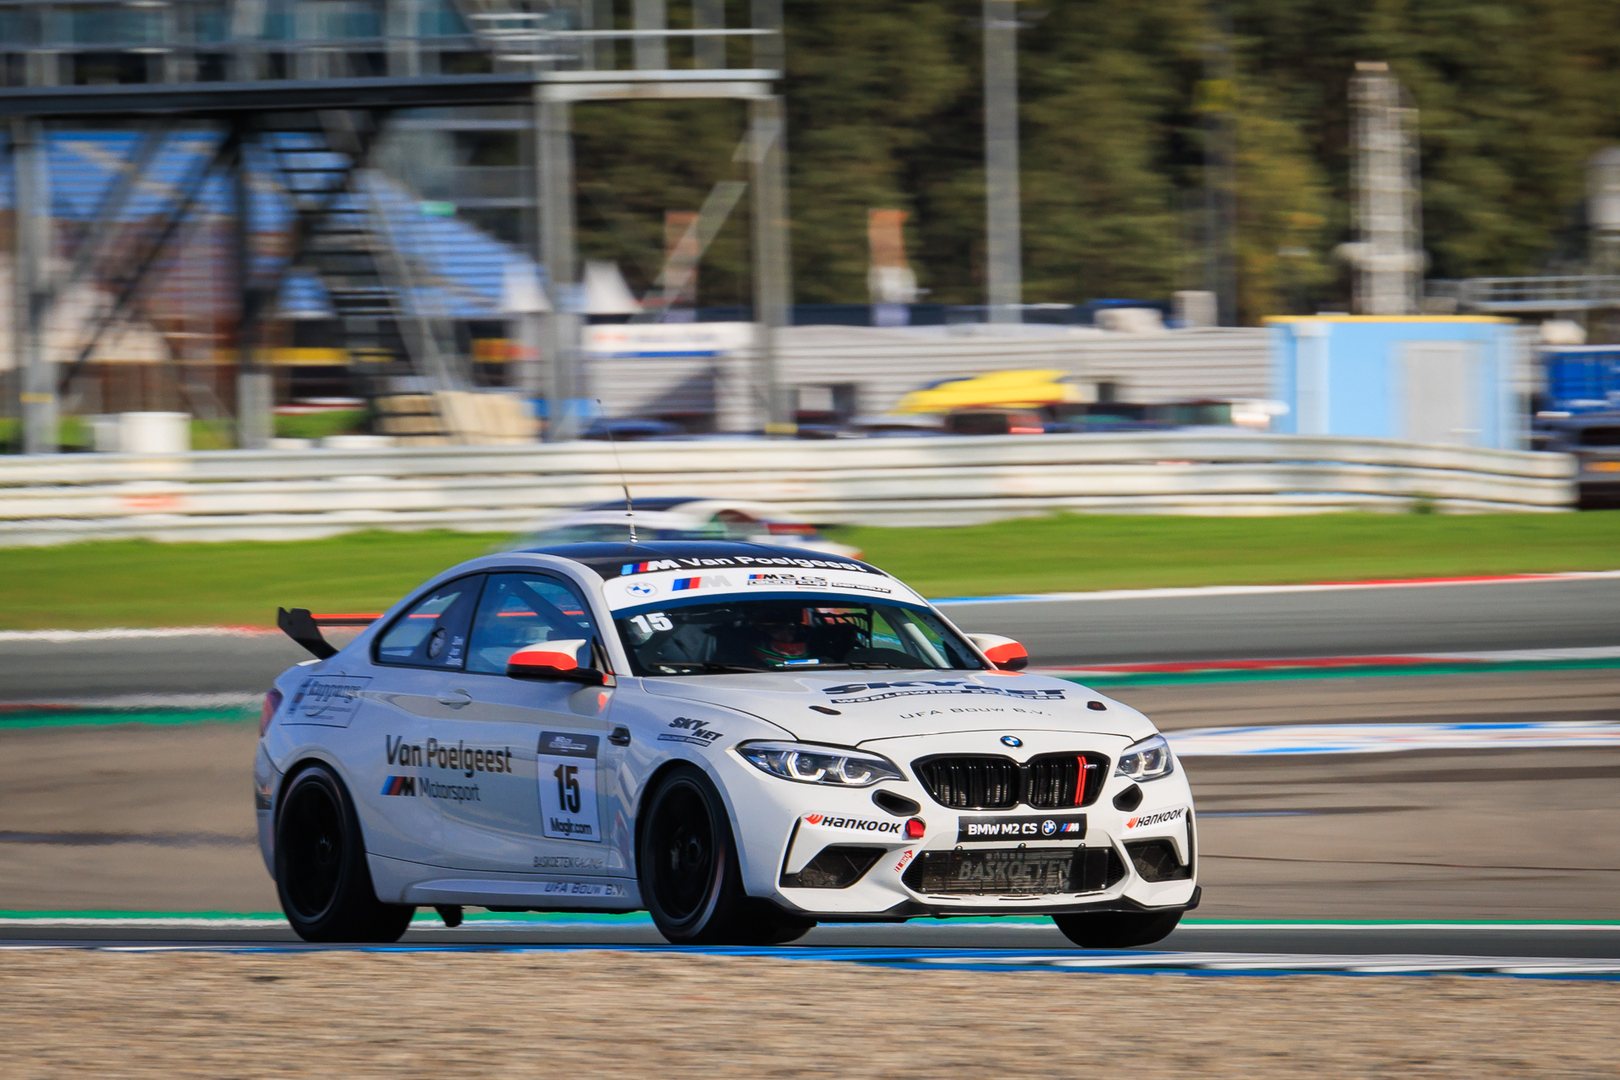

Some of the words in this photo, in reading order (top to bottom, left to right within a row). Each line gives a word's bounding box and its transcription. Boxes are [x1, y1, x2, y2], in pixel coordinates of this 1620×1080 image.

[678, 557, 735, 567] Van
[733, 555, 868, 573] Poelgeest
[630, 612, 674, 633] 15
[899, 708, 944, 719] UFA
[669, 717, 710, 730] SKY
[692, 729, 724, 741] NET
[385, 734, 423, 767] Van
[427, 737, 512, 778] Poelgeest
[418, 777, 481, 804] Motorsport
[553, 763, 581, 814] 15
[967, 823, 1000, 836] BMW
[1001, 823, 1020, 835] M2
[1022, 823, 1038, 835] CS
[958, 859, 1073, 880] BASKOETEN
[544, 882, 568, 892] UFA
[605, 883, 626, 896] B.V.
